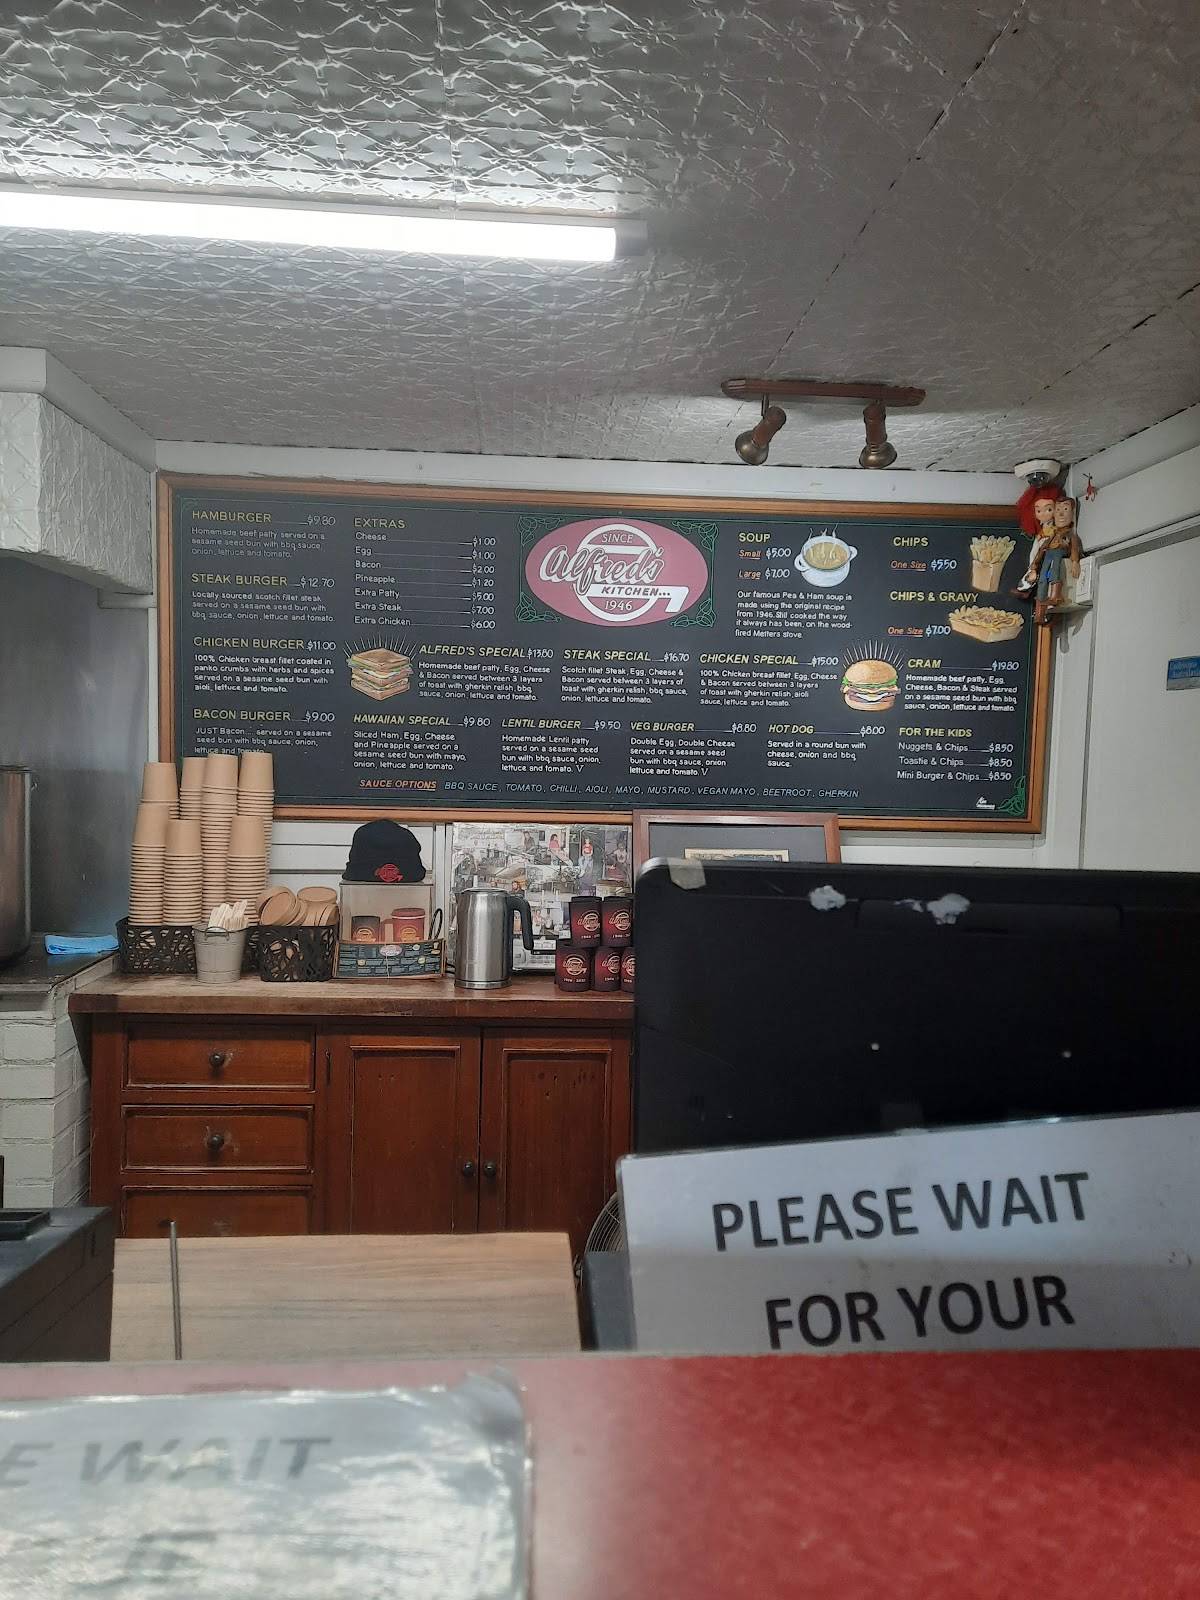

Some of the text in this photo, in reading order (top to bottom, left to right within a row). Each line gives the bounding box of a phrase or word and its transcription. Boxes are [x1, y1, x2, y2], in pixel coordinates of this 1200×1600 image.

[192, 511, 272, 522] HAMBURGER
[354, 518, 405, 528] EXTRAS
[356, 532, 386, 540] Cheese
[602, 534, 633, 544] SINCE
[739, 533, 770, 542] SOUP
[893, 537, 928, 546] CHIPS
[356, 546, 372, 556] Egg
[766, 548, 791, 559] $5.00
[356, 574, 395, 583] Pineapple
[739, 568, 790, 579] Large $7.00
[192, 574, 335, 588] STEAK BURGER $12.70
[355, 588, 376, 597] Extra
[379, 590, 400, 599] Patty
[890, 592, 978, 602] CHIPS & GRAVY
[355, 602, 376, 610] Extra
[379, 603, 401, 611] Steak
[605, 601, 633, 611] 1946
[354, 616, 376, 624] Extra
[379, 617, 410, 626] Chicken
[194, 637, 249, 647] CHICKEN
[253, 639, 304, 649] BURGER
[419, 645, 475, 655] ALFRED'S
[479, 648, 526, 658] SPECIAL
[564, 650, 600, 660] STEAK
[604, 651, 650, 661] SPECIAL
[700, 654, 749, 664] CHICKEN
[753, 655, 799, 665] SPECIAL
[908, 659, 941, 668] CRAM
[194, 709, 236, 719] BACON
[241, 711, 290, 721] BURGER
[354, 715, 490, 727] HAWAIIAN SPECIAL $9.80
[502, 719, 621, 731] LENTIL BURGER $9.50
[631, 722, 650, 730] VEG
[653, 723, 695, 731] BURGER
[769, 725, 790, 733] HOT
[792, 725, 814, 734] DOG
[354, 731, 377, 739] Sliced
[381, 732, 402, 740] Ham,
[899, 728, 972, 737] FOR THE KIDS
[371, 742, 410, 750] Pineapple
[572, 737, 590, 746] patty
[899, 743, 932, 752] Nuggets
[945, 743, 968, 752] Chips
[767, 751, 797, 759] cheese,
[841, 752, 856, 761] bbq
[354, 761, 377, 769] onion,
[380, 761, 406, 769] lettuce
[426, 762, 454, 770] tomato.
[940, 758, 964, 766] Chips
[897, 771, 913, 779] Mini
[916, 772, 944, 781] Burger
[948, 772, 953, 780] &
[956, 772, 980, 781] Chips
[360, 780, 392, 788] SAUCE
[394, 780, 436, 789] OPTIONS
[445, 782, 464, 790] BBQ
[819, 790, 859, 798] GHERKIN
[713, 1171, 1089, 1252] PLEASE WAIT
[765, 1275, 1075, 1349] FOR YOUR
